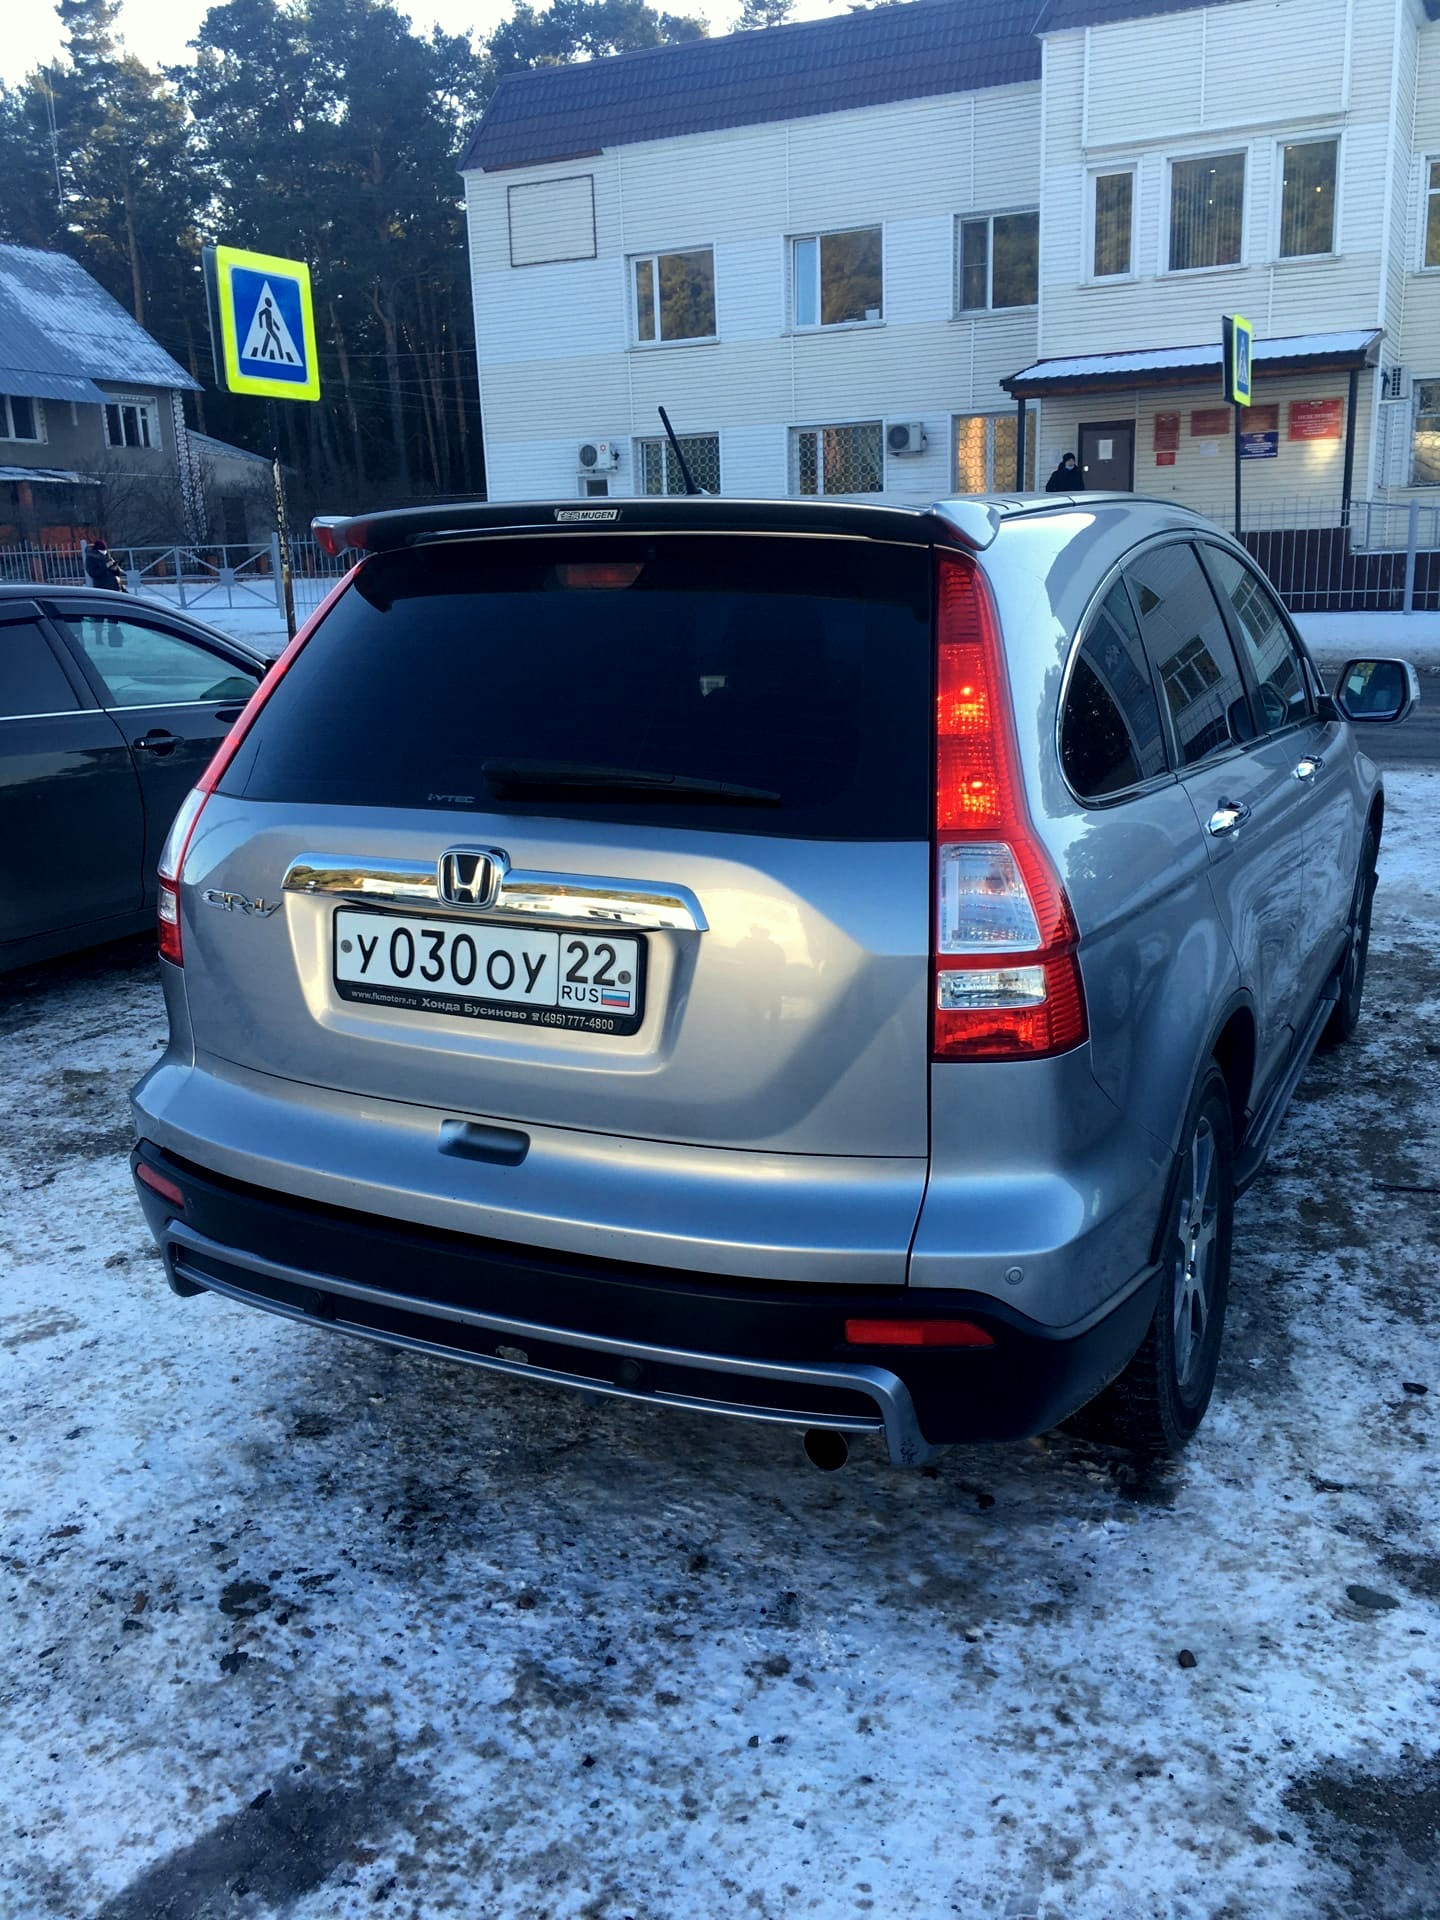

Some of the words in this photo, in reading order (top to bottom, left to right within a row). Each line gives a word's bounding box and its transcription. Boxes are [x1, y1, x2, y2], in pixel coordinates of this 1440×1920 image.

[580, 511, 615, 519] MUGEN
[565, 940, 617, 987] 22
[561, 985, 600, 1004] RUS
[421, 997, 461, 1012] Хонда
[464, 1003, 528, 1019] Бусиново
[567, 1015, 614, 1031] 777-4800
